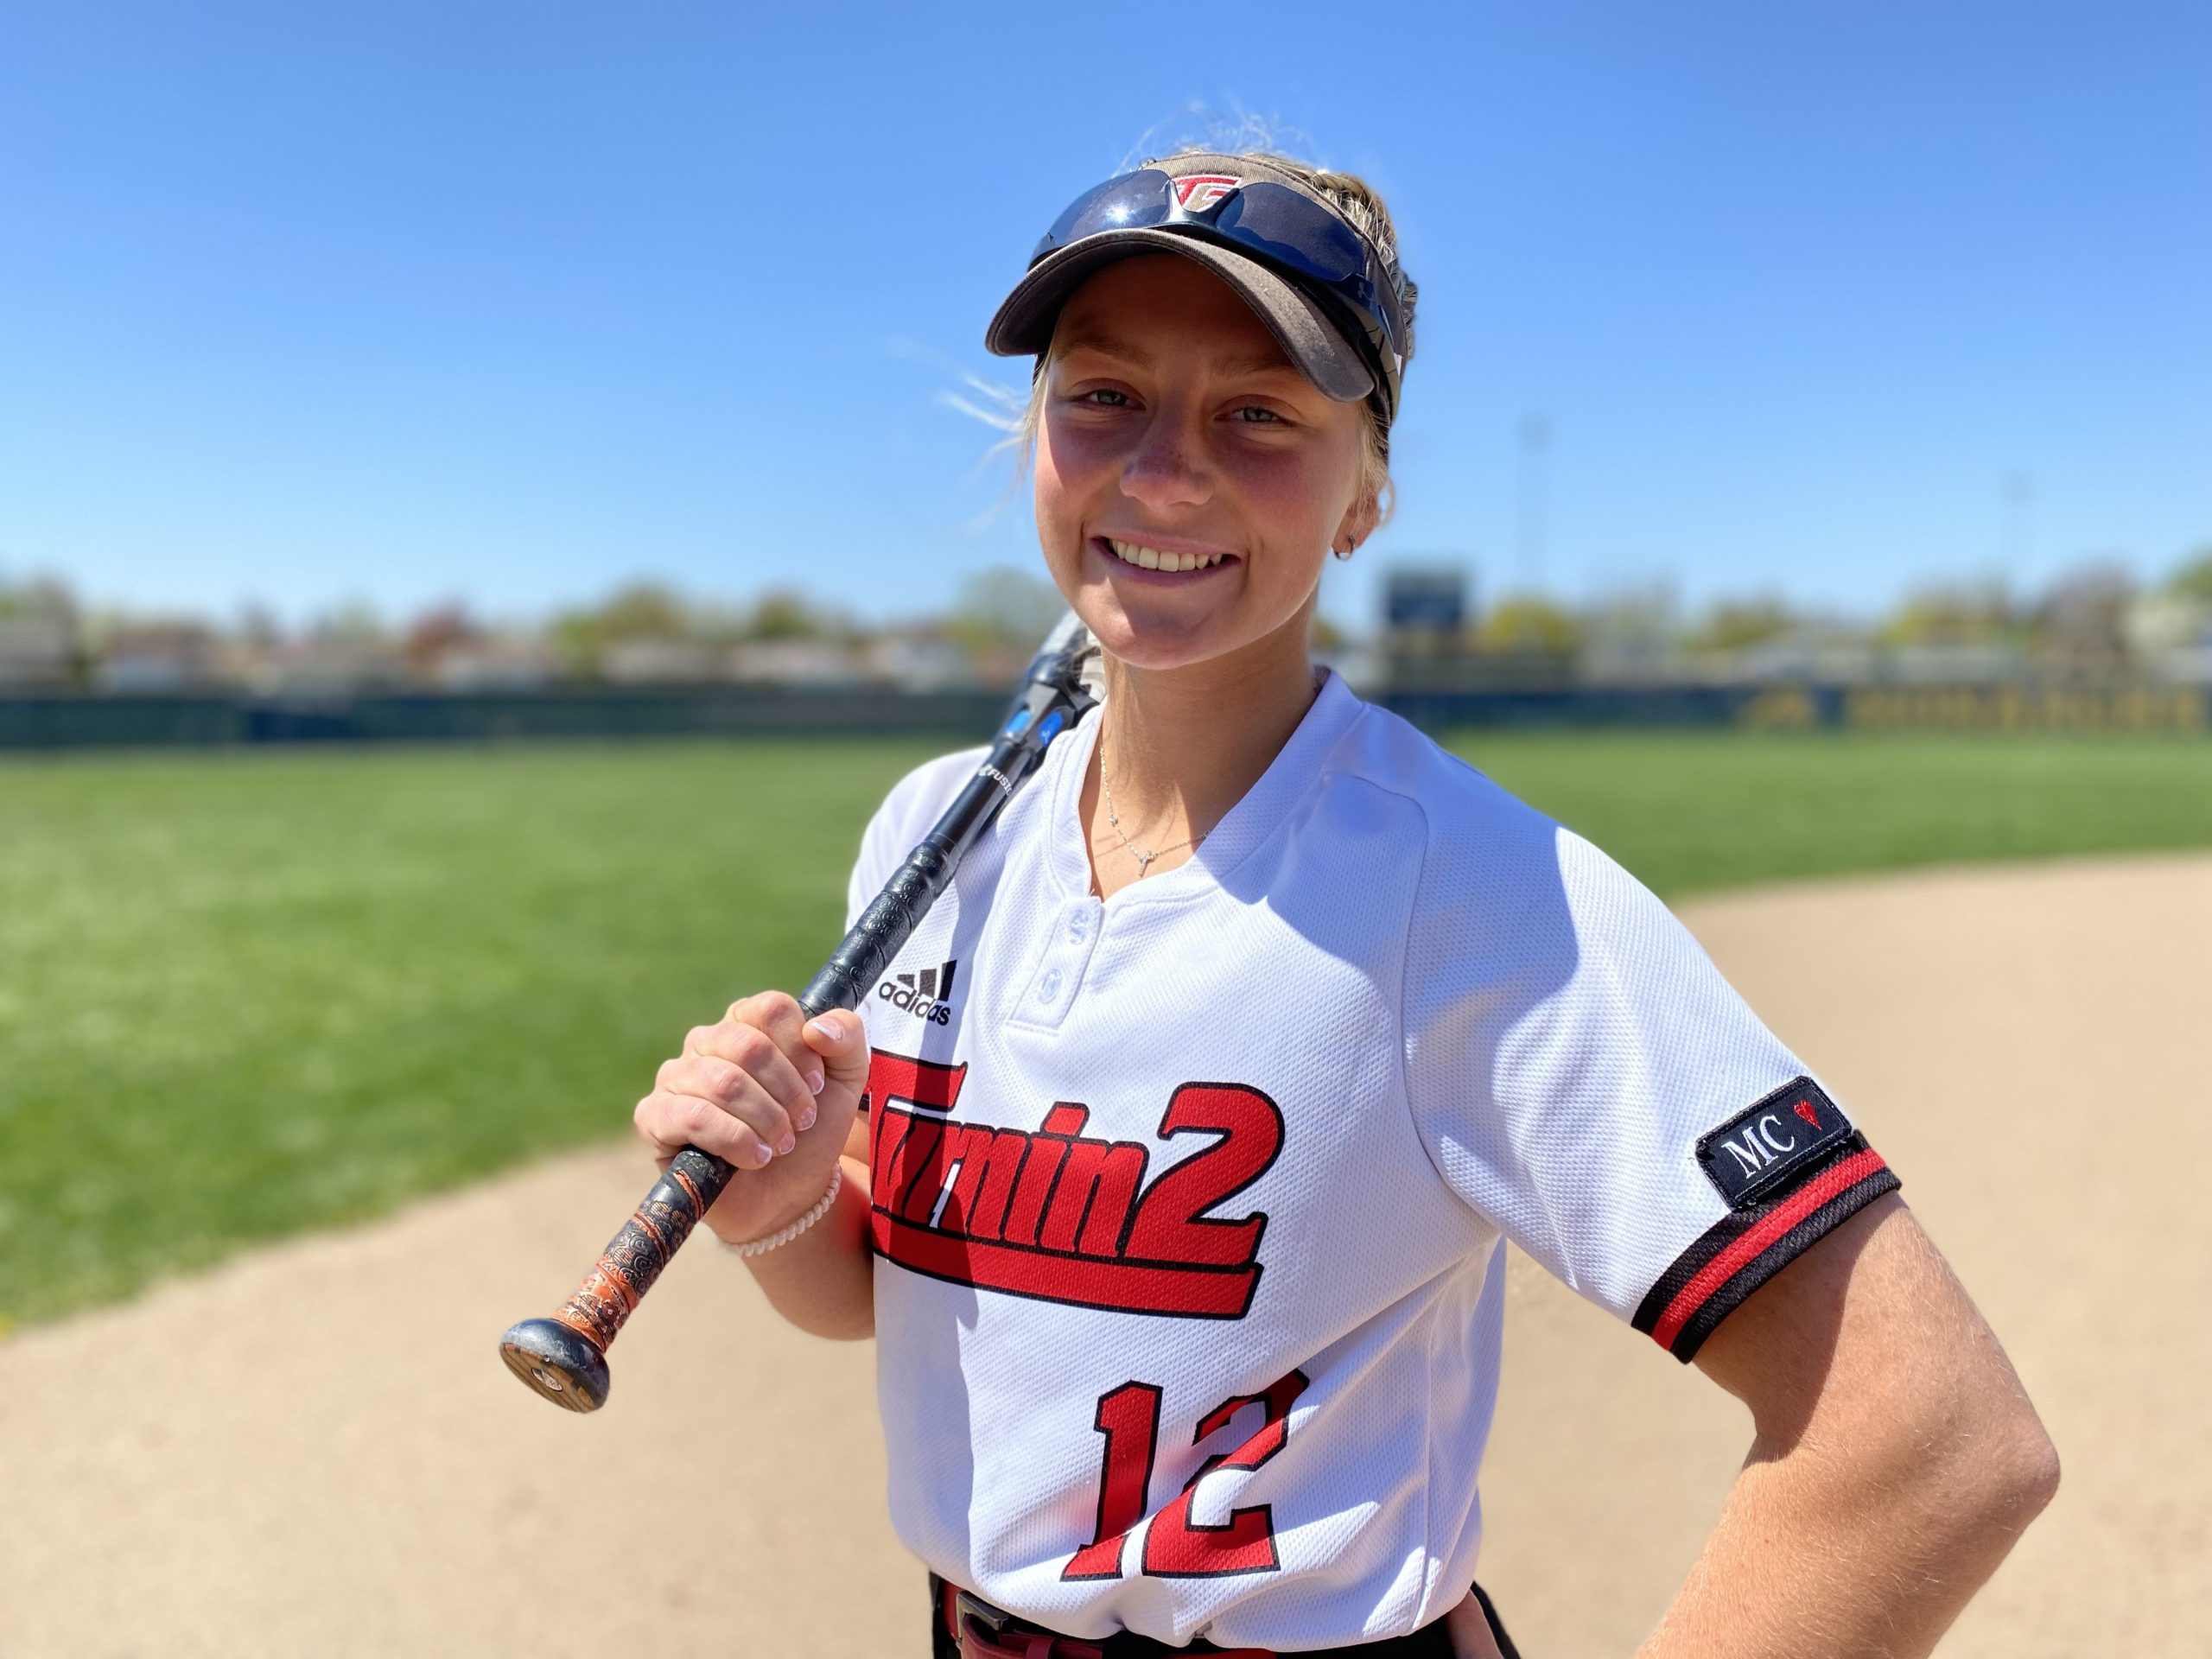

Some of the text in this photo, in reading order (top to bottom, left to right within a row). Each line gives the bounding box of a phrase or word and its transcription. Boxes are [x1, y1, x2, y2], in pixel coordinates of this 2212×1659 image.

[879, 982, 950, 1026] adidas
[1720, 1115, 1795, 1179] MC
[1059, 1367, 1310, 1582] 12
